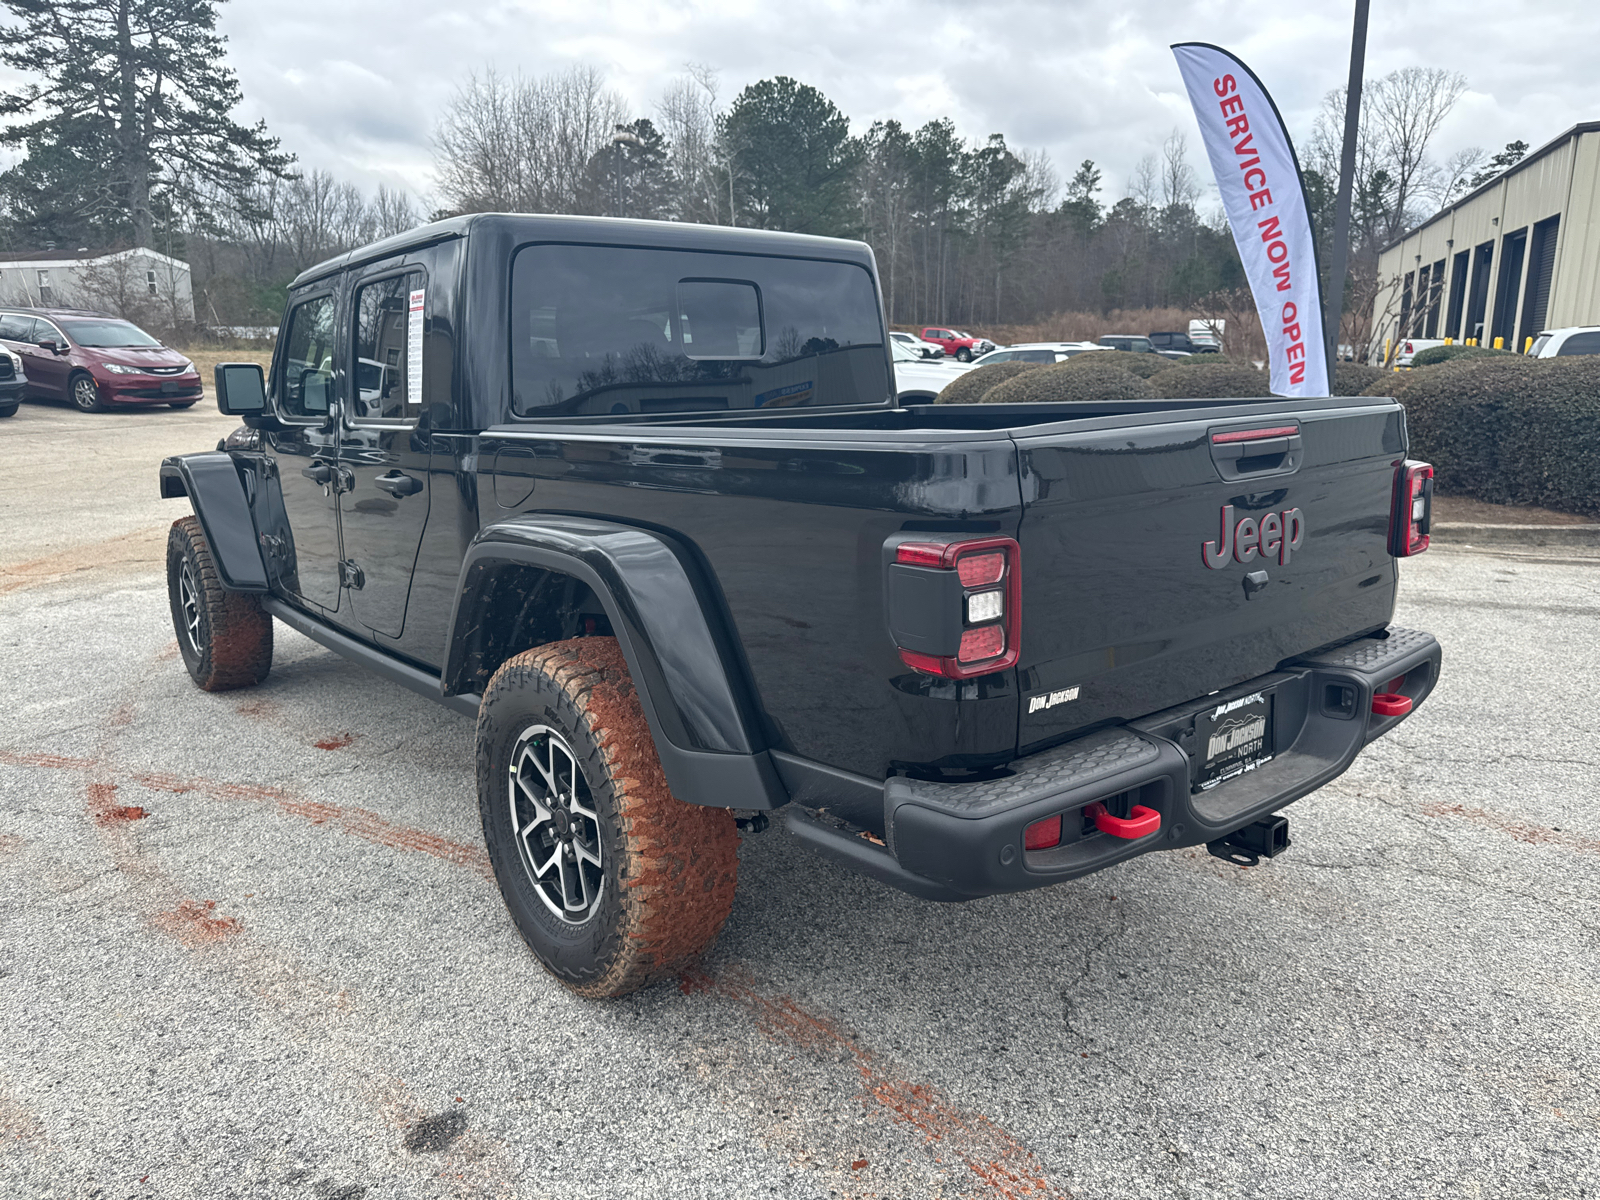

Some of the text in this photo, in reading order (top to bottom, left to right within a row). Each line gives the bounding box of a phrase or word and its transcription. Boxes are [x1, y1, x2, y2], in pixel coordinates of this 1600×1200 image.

[1213, 73, 1305, 386] SERVICE NOW OPEN
[1203, 504, 1305, 570] Jeep
[1028, 686, 1079, 714] DON JACKSON
[1206, 719, 1266, 761] DON JACKSON
[1237, 738, 1263, 759] NORTH
